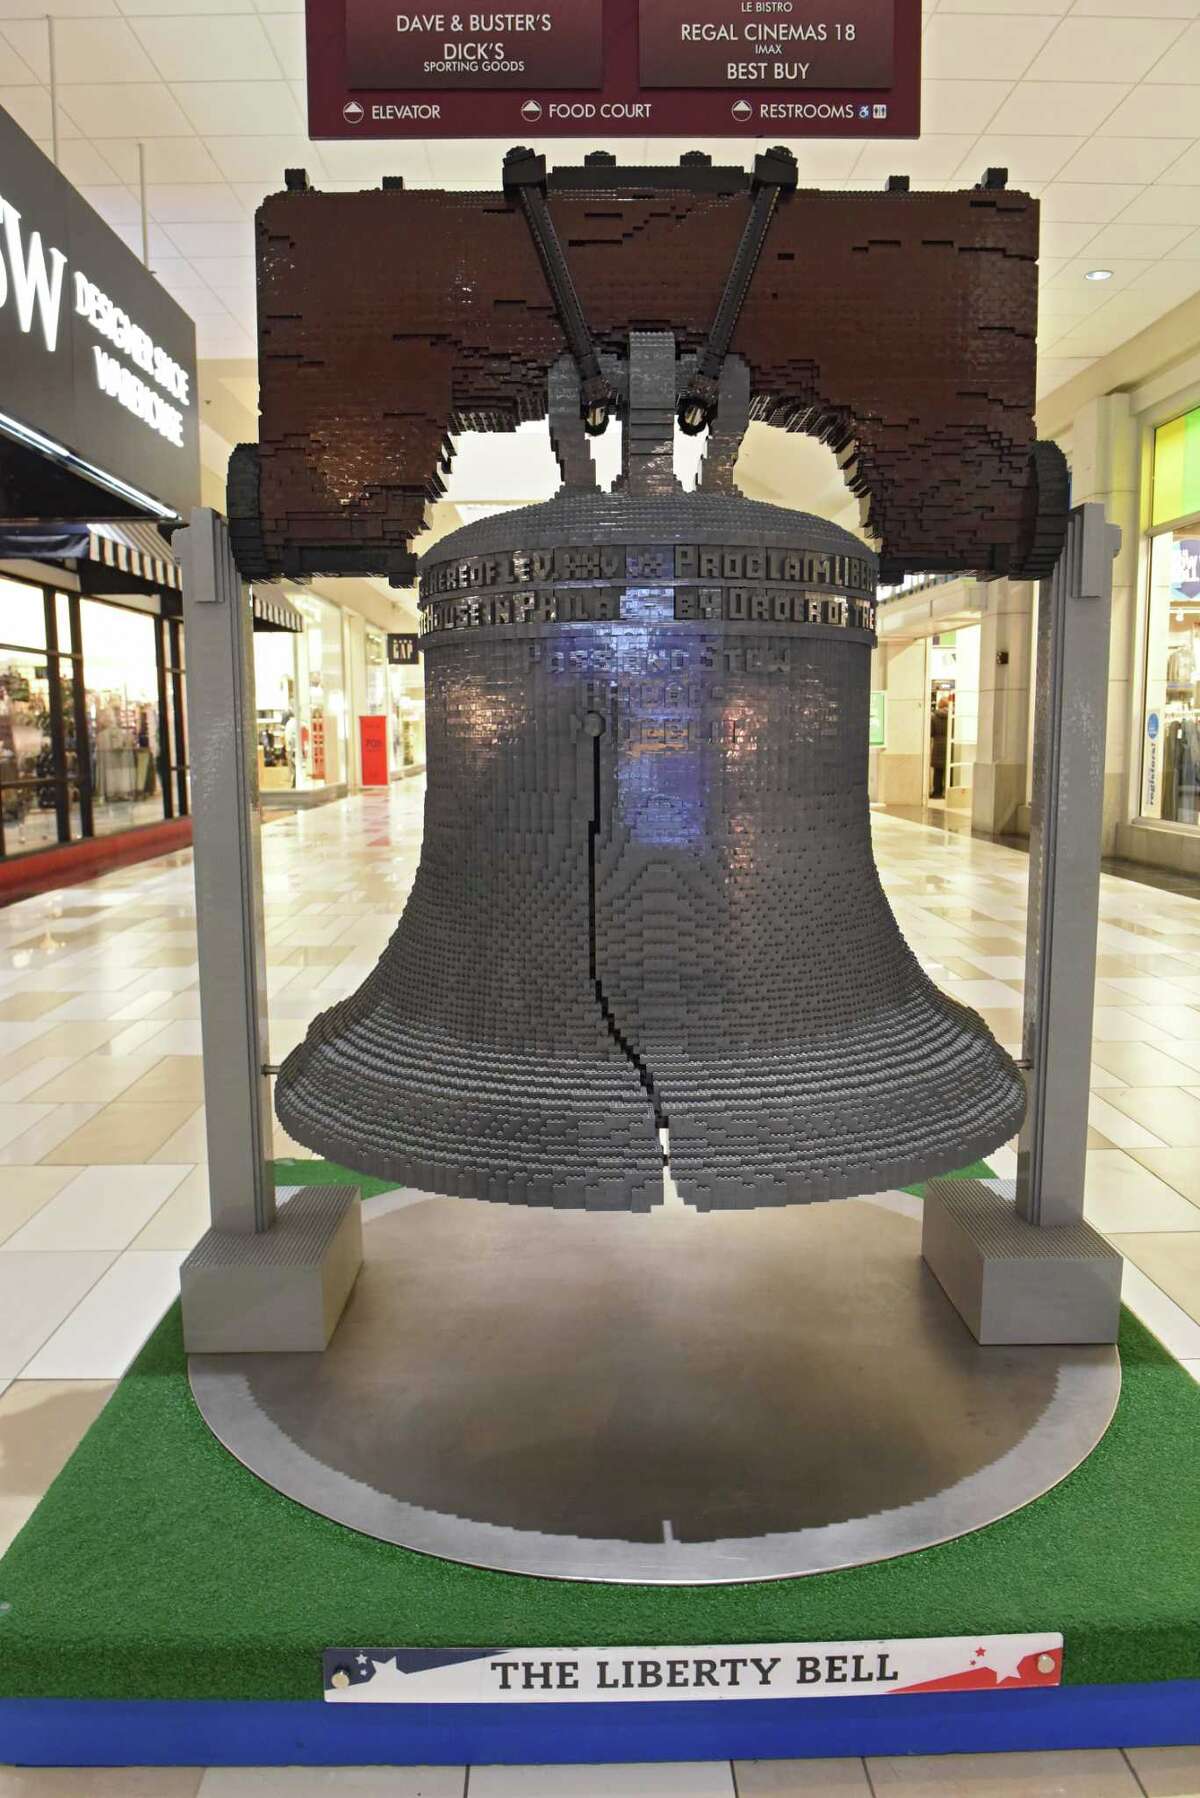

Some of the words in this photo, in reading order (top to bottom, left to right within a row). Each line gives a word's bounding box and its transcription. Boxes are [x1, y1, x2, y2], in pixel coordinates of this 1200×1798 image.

[741, 2, 752, 12] LE
[755, 2, 793, 13] BISTRO
[396, 15, 445, 32] DAVE
[450, 15, 463, 31] &
[470, 14, 551, 31] BUSTER'S
[681, 24, 739, 41] REGAL
[744, 24, 827, 41] CINEMAS
[834, 24, 856, 41] 18
[444, 43, 504, 60] DICK'S
[755, 44, 782, 54] IMAX
[424, 61, 479, 72] SPORTING
[482, 61, 525, 72] GOODS
[727, 63, 768, 79] BEST
[774, 63, 809, 79] BUY
[371, 105, 441, 120] ELEVATOR
[549, 104, 596, 118] FOOD
[600, 104, 652, 118] COURT
[760, 104, 854, 119] RESTROOMS
[491, 1661, 579, 1689] THE
[596, 1657, 781, 1689] LIBERTY
[796, 1654, 899, 1684] BELL
